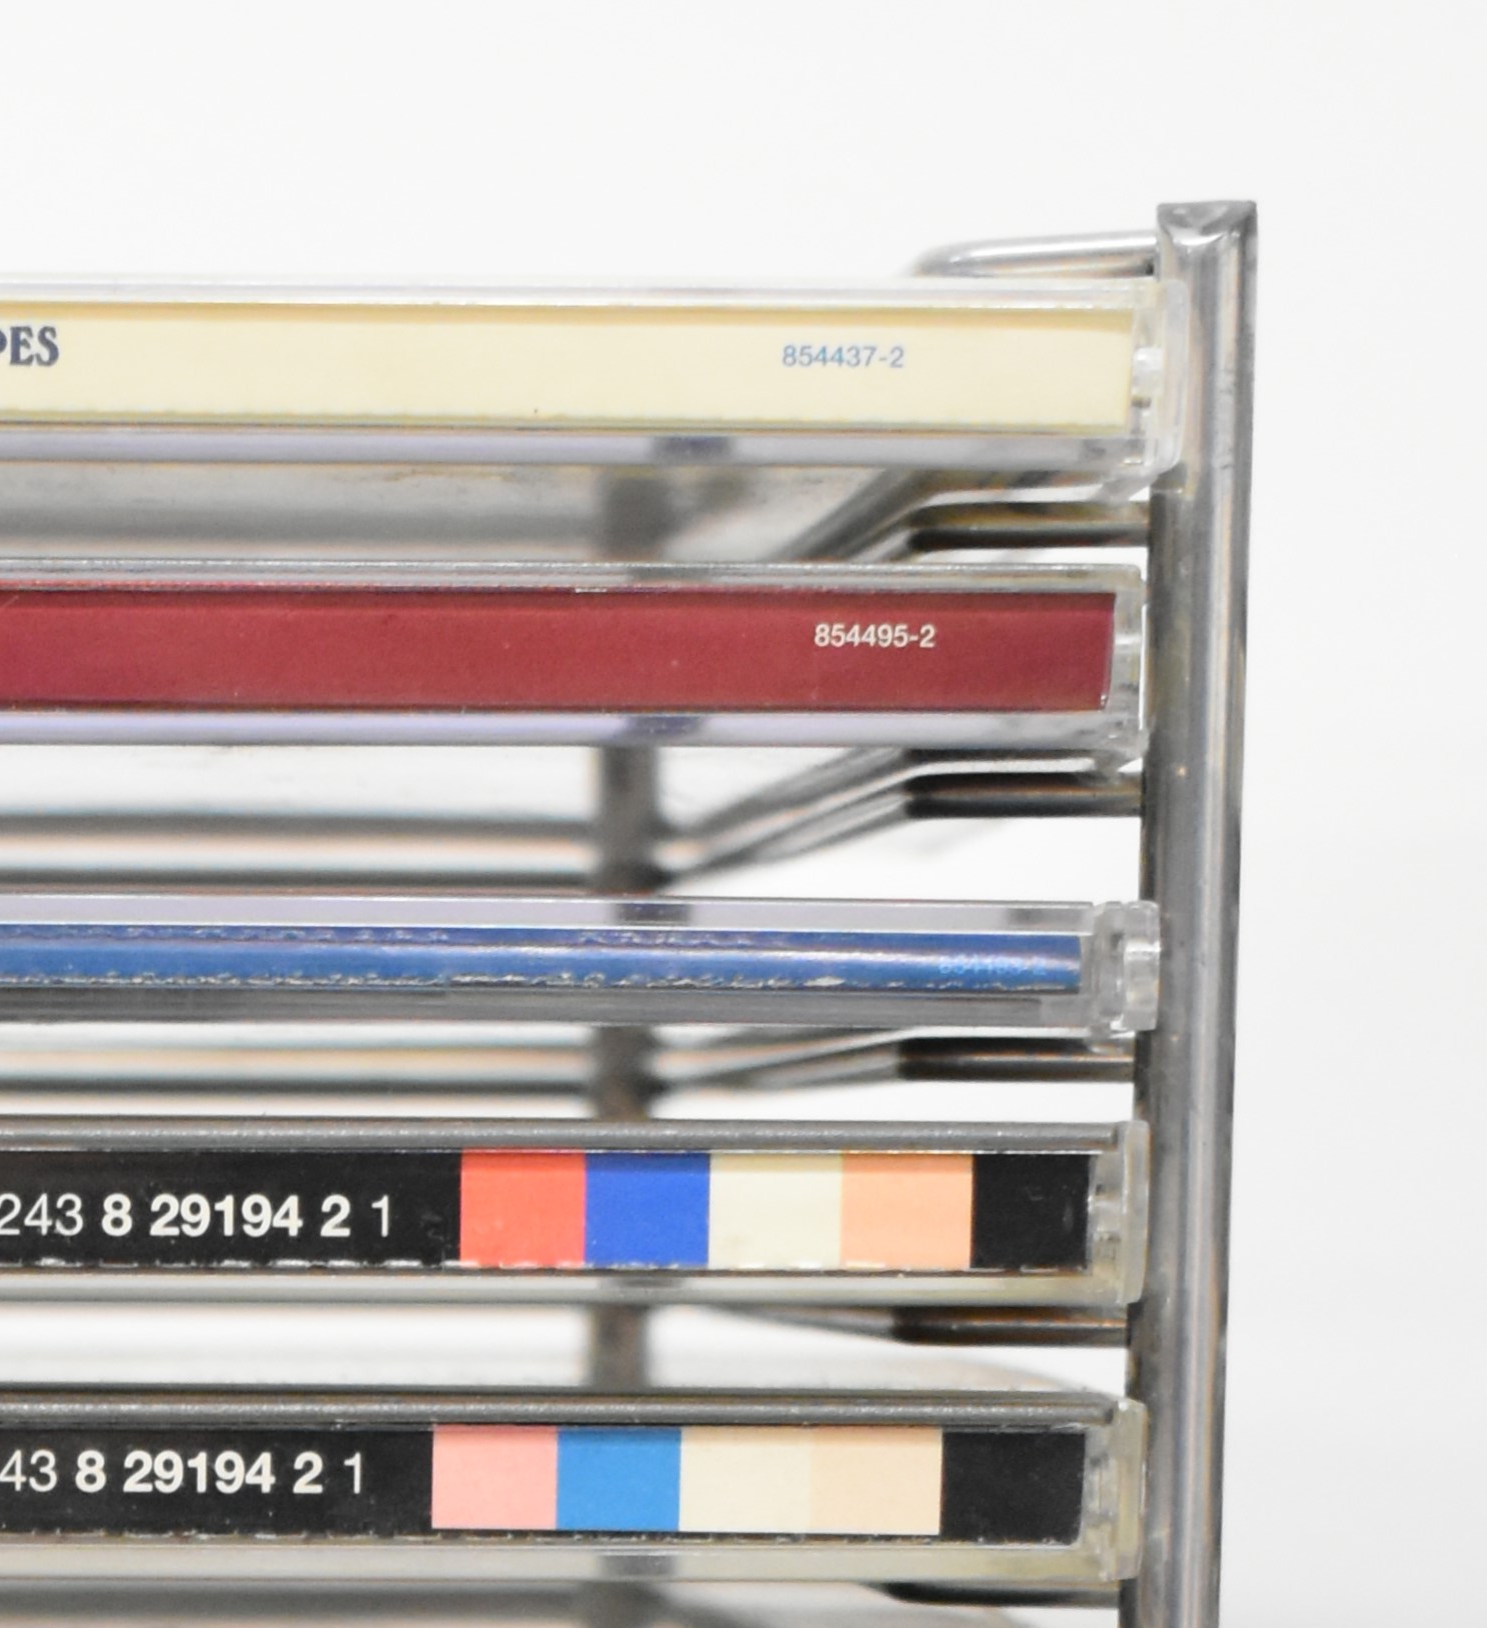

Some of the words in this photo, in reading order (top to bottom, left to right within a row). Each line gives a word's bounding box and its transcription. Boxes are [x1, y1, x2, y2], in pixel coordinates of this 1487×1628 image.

[782, 345, 904, 368] 854437-2
[814, 624, 935, 648] 854495-2
[103, 1194, 131, 1237] 8
[150, 1194, 302, 1237] 29194
[321, 1194, 351, 1237] 2
[372, 1196, 390, 1237] 1
[74, 1451, 105, 1494] 8
[123, 1451, 275, 1494] 29194
[292, 1452, 324, 1495] 2
[346, 1453, 364, 1495] 1
